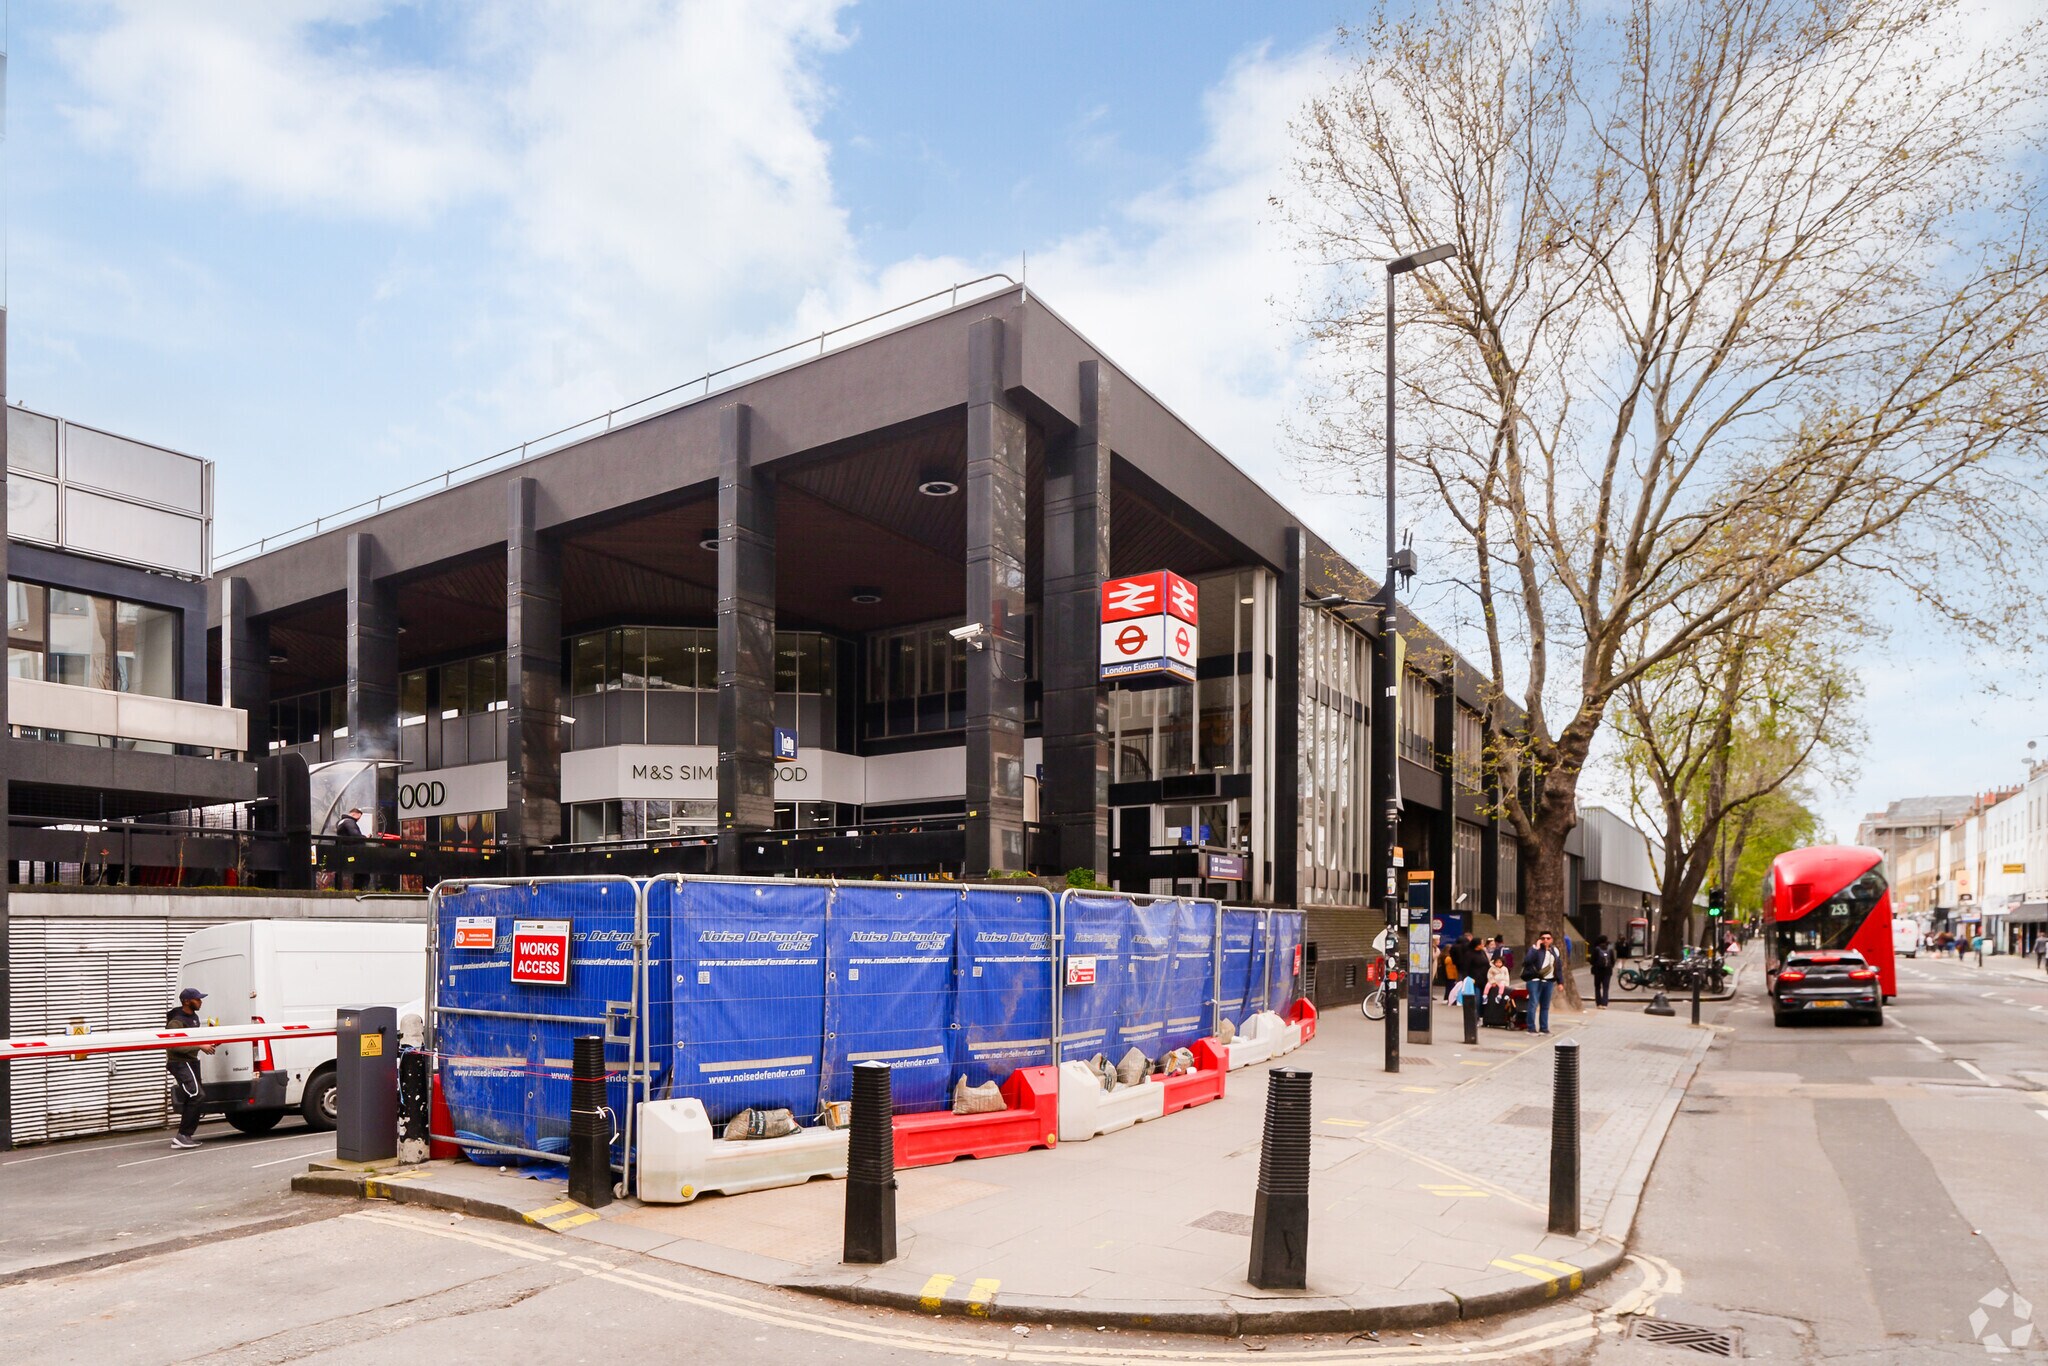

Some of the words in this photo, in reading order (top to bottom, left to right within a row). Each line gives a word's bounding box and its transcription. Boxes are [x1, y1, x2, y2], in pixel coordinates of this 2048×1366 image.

[1105, 665, 1132, 675] London
[1133, 661, 1159, 671] Euston
[632, 765, 673, 780] M&S
[680, 766, 719, 780] SIM
[774, 767, 807, 781] OD
[399, 781, 446, 809] OOD
[1831, 904, 1848, 915] 253
[588, 930, 659, 941] Defenr
[699, 930, 745, 942] Noise
[746, 931, 818, 942] Defender
[849, 931, 889, 942] Noise
[890, 931, 951, 942] Defender
[976, 932, 1008, 942] Noise
[1008, 933, 1052, 942] Defende
[520, 942, 560, 956] WORKS
[699, 958, 818, 967] www.noisedefender.com
[849, 957, 949, 965] www.noisedefender.com
[517, 959, 561, 975] ACCESS
[453, 1068, 525, 1078] www.noisedefender.com
[709, 1068, 806, 1084] www.noisedefender.com
